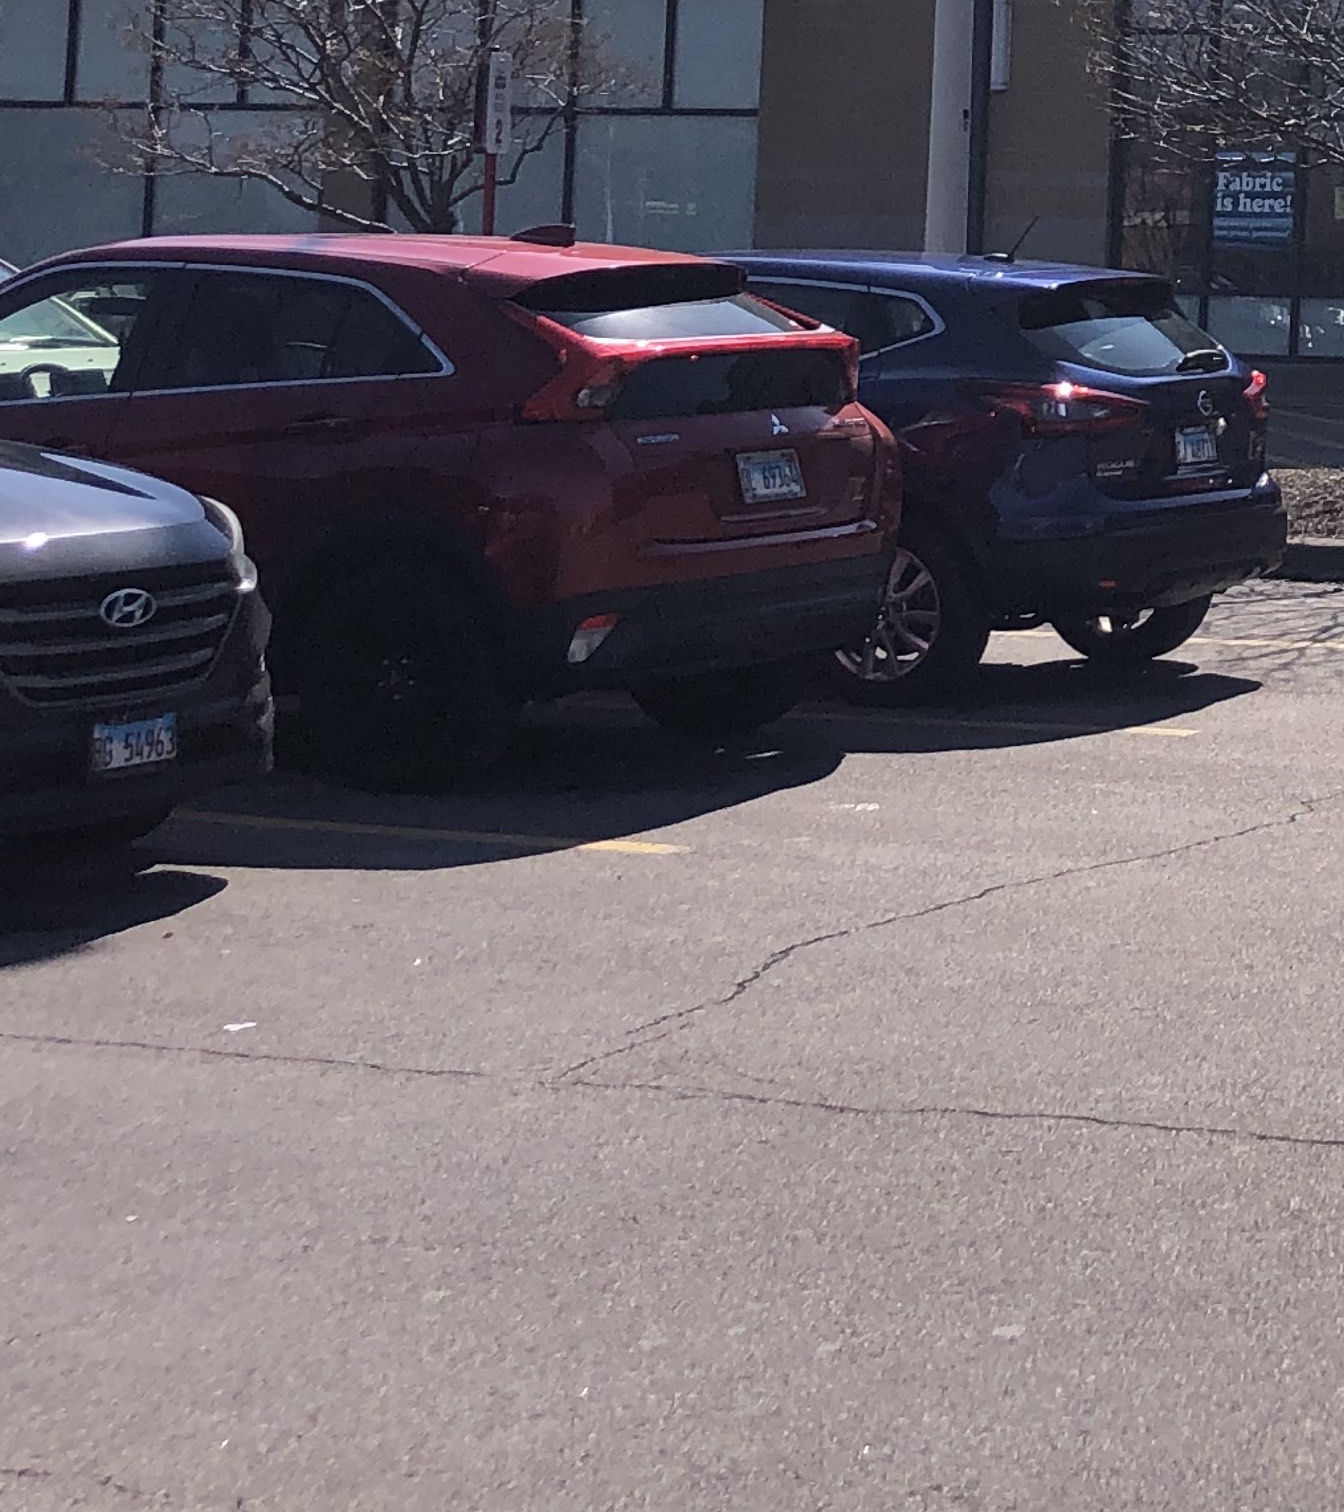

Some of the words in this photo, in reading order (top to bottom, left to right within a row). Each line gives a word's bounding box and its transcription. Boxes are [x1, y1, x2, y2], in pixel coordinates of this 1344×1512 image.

[1216, 172, 1283, 192] Fabric
[1215, 192, 1234, 212] is
[1238, 192, 1292, 213] here!
